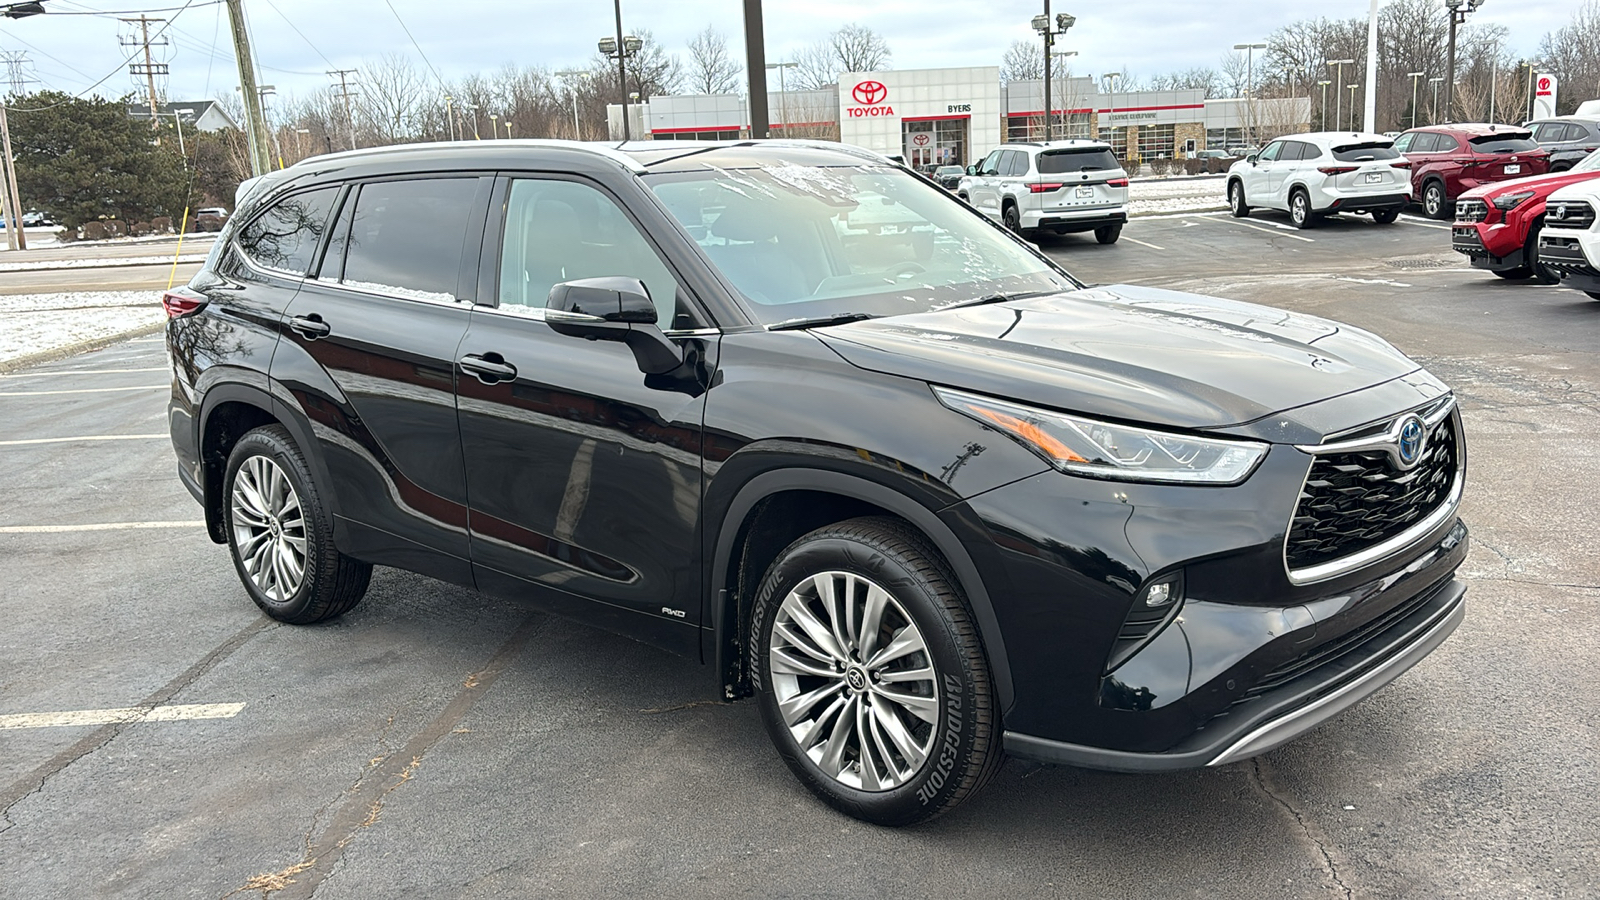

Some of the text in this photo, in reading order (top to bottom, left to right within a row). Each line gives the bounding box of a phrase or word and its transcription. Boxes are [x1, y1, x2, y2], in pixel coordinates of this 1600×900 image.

[847, 106, 894, 117] TOYOTA
[947, 104, 972, 113] BYERS
[661, 606, 686, 618] AWD
[750, 570, 784, 691] BRIDGESTONE
[916, 673, 962, 806] BRIDGESTONE
